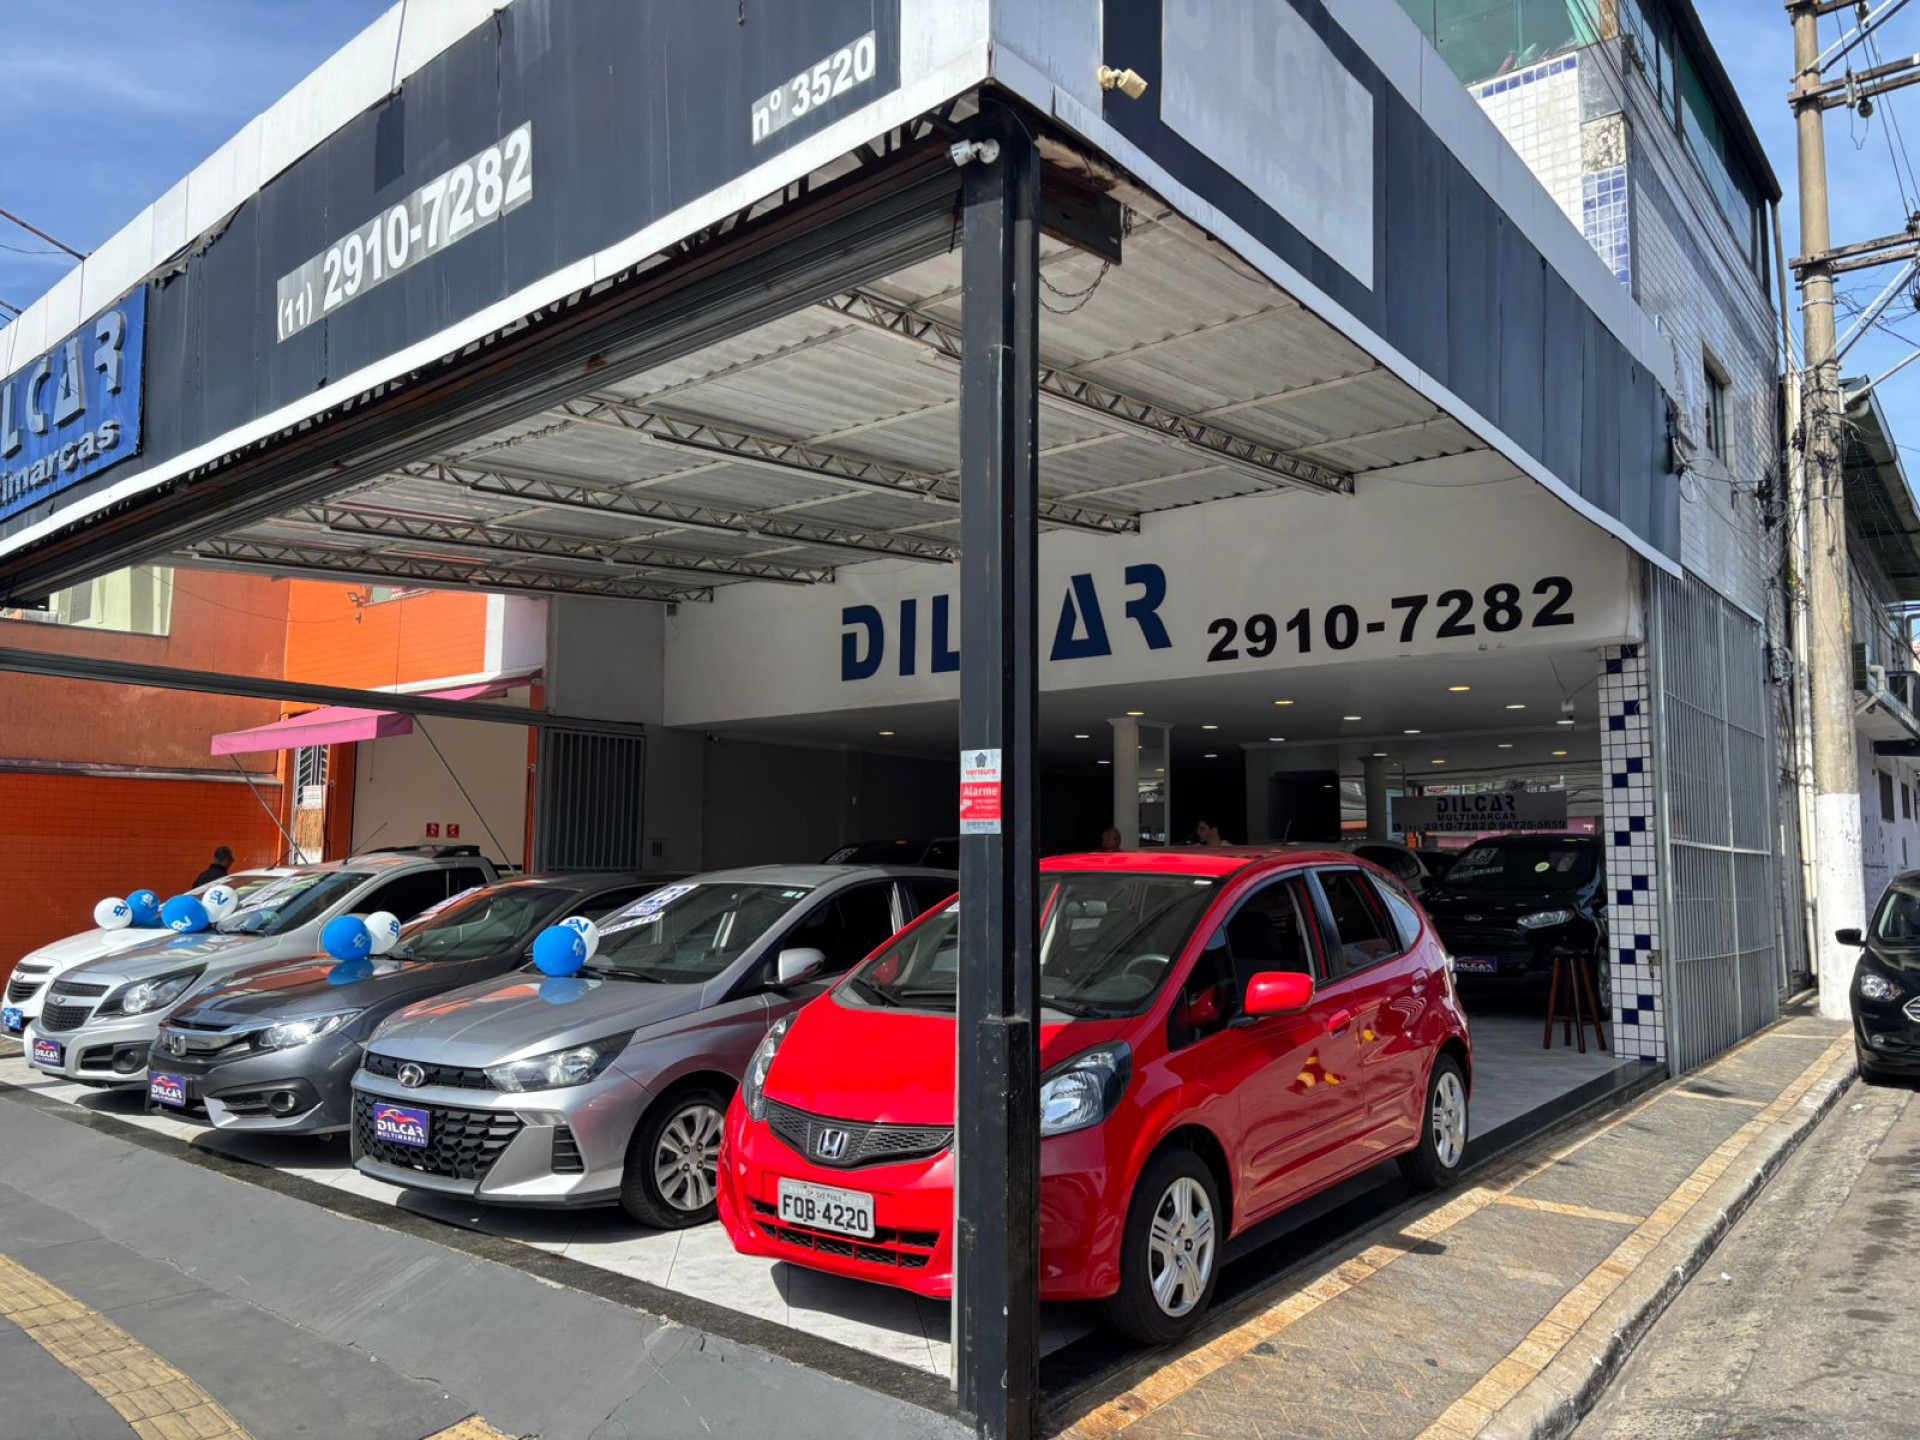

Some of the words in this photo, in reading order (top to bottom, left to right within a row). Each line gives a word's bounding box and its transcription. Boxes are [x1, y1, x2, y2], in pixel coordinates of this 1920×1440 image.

[791, 36, 875, 117] 3520
[278, 281, 313, 342] (11)
[323, 127, 531, 311] 2910-7282
[0, 419, 121, 502] imarcas
[842, 564, 1173, 682] DILAR
[1207, 576, 1575, 662] 2910-7282
[963, 785, 998, 797] Alarme
[1437, 795, 1516, 813] DILCAR
[377, 1119, 424, 1138] DILCAR
